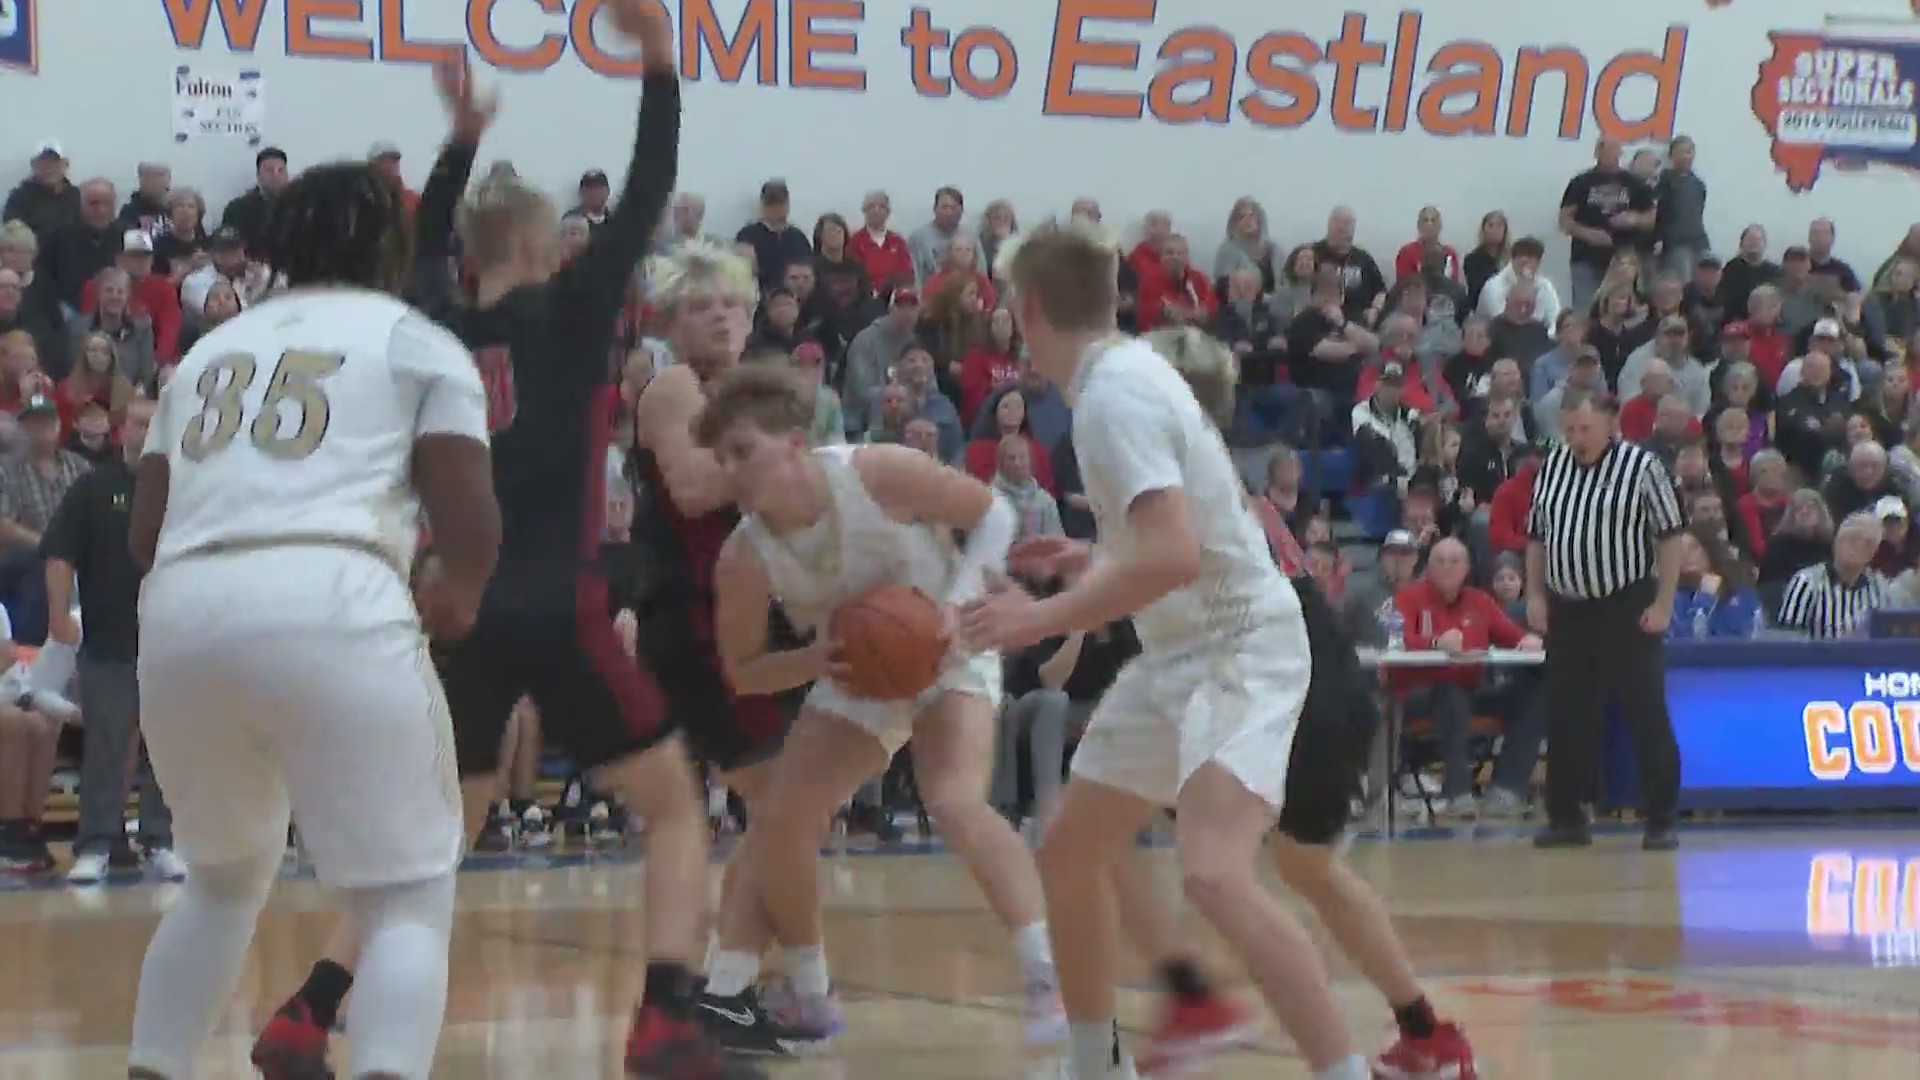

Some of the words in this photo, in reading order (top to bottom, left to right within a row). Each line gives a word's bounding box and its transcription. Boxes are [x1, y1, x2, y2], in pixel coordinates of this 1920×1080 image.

[161, 0, 867, 91] WELCOME
[902, 7, 1018, 98] to
[1042, 0, 1689, 143] Eastland
[1795, 49, 1897, 78] SUPER
[175, 75, 233, 98] Fulton
[1777, 75, 1914, 107] SECTIONALS
